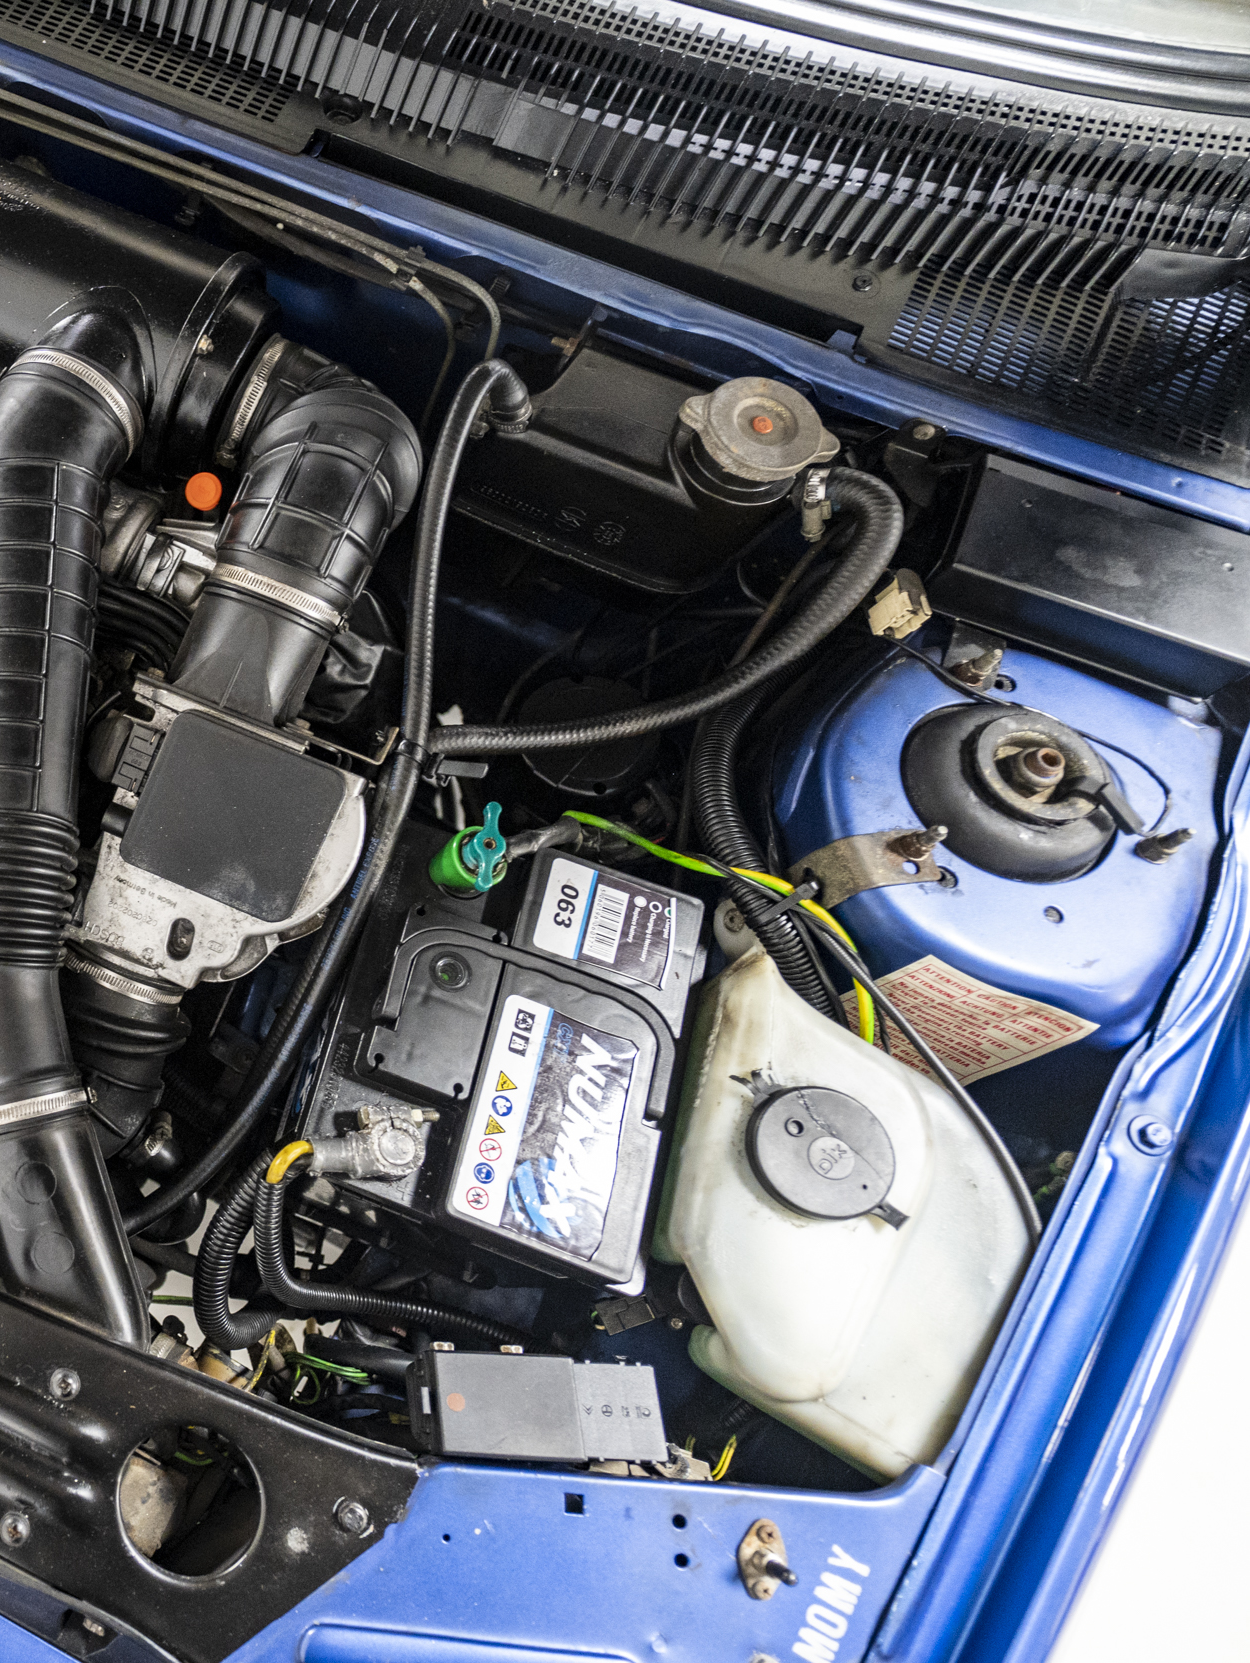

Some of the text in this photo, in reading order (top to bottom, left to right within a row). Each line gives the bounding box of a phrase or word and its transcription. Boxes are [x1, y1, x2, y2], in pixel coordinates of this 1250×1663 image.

[552, 884, 580, 928] 063
[627, 907, 640, 942] Replace battery
[645, 912, 656, 934] Charging
[639, 939, 650, 961] Necessary
[908, 974, 1053, 1039] ATTENZIONE ACHTUNG ATTENTIE
[922, 966, 1073, 1032] ATTENTION CAUTION ATENCION
[887, 992, 909, 1005] Never
[910, 1004, 952, 1025] disconnect
[953, 1023, 968, 1032] the
[968, 1030, 1009, 1050] BATTERY
[901, 1006, 917, 1015] the
[916, 1014, 943, 1028] engine
[951, 1030, 983, 1046] running
[992, 1024, 1037, 1045] BATTERIE
[892, 1053, 920, 1068] werden
[900, 1049, 919, 1059] darf
[929, 1045, 969, 1067] BATTERIA
[955, 1041, 991, 1059] BATERIA
[538, 1033, 611, 1237] NUMAX
